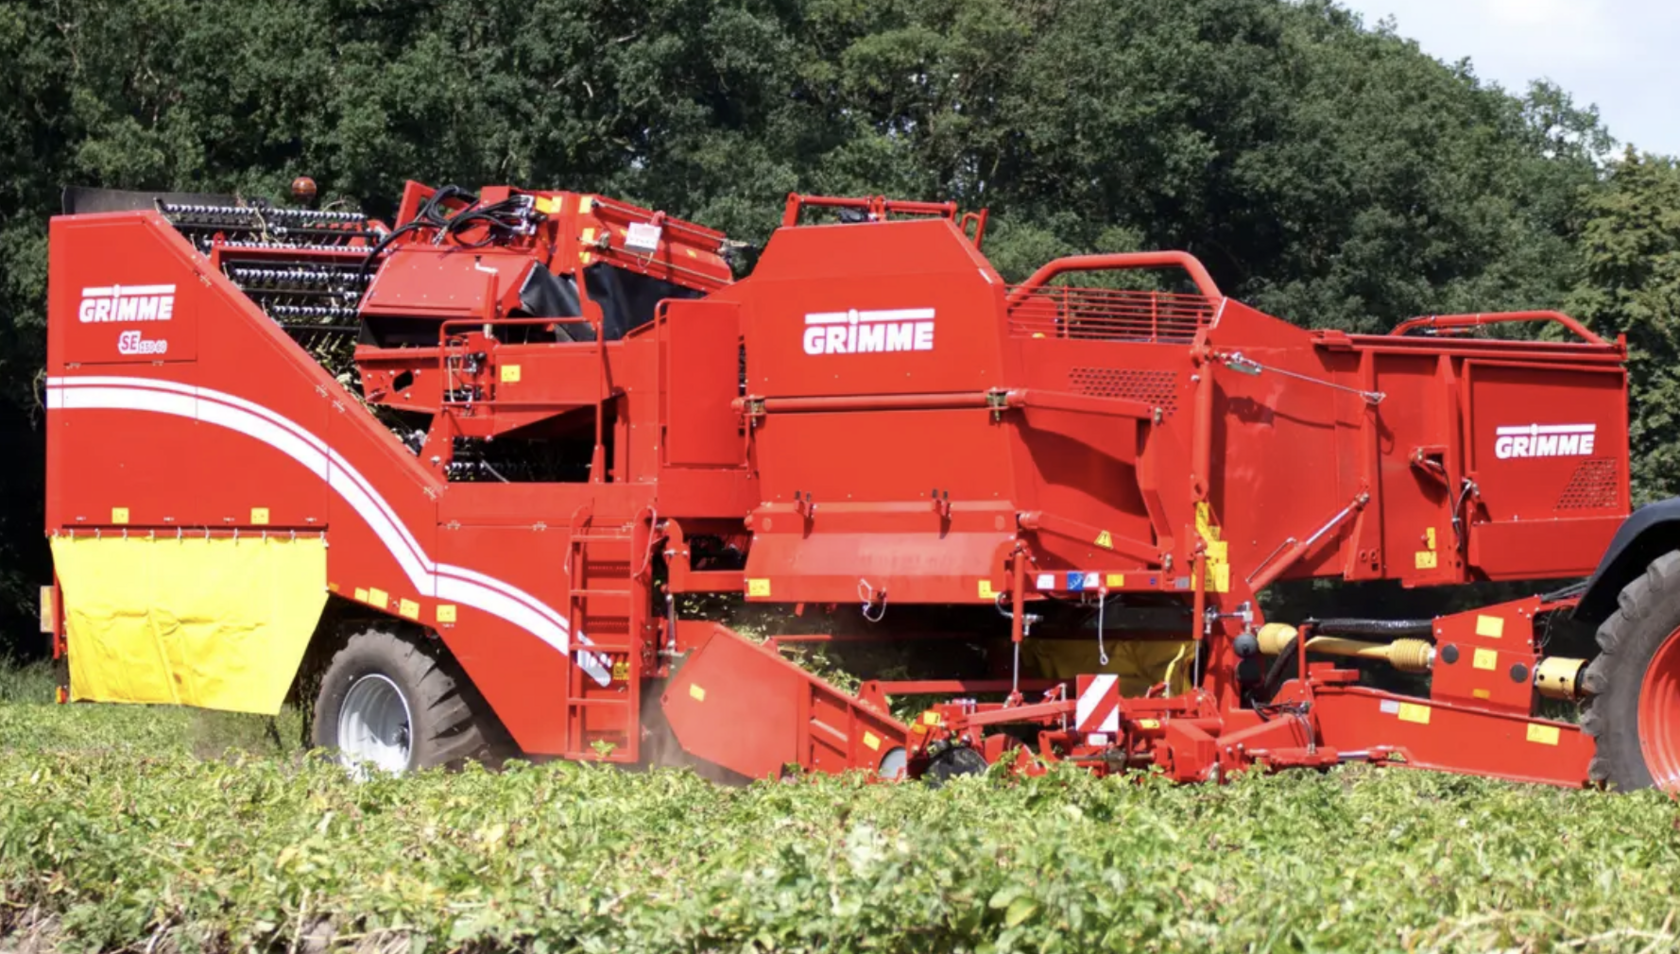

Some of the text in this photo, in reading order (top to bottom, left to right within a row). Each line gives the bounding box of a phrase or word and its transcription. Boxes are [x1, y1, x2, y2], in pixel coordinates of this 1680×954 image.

[79, 284, 176, 323] GRIMME
[119, 332, 141, 353] SE
[803, 308, 935, 355] GRIMME
[1495, 423, 1596, 459] GRIMME
